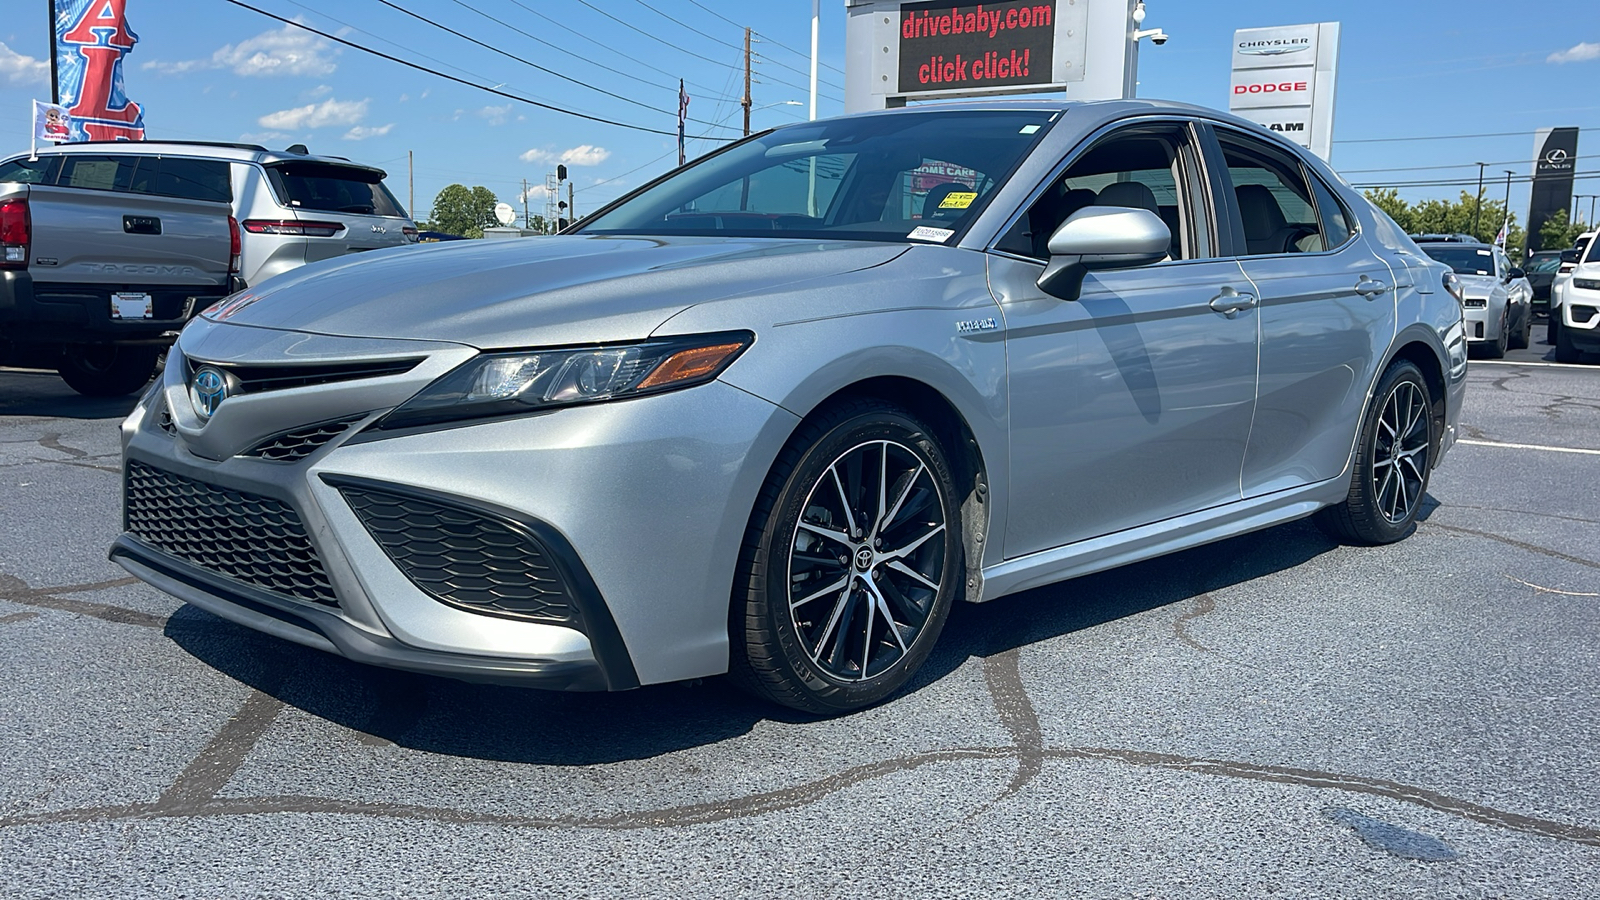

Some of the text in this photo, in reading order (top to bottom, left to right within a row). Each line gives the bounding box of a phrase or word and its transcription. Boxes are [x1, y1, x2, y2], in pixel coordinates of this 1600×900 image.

[902, 4, 1052, 39] drivebaby.com
[1239, 38, 1309, 48] CHRYSLER
[63, 0, 144, 141] AL
[918, 49, 1030, 84] click click!
[1234, 82, 1307, 95] DODGE
[1260, 123, 1304, 132] AM
[946, 167, 975, 176] CARE
[80, 263, 195, 276] TACOMA
